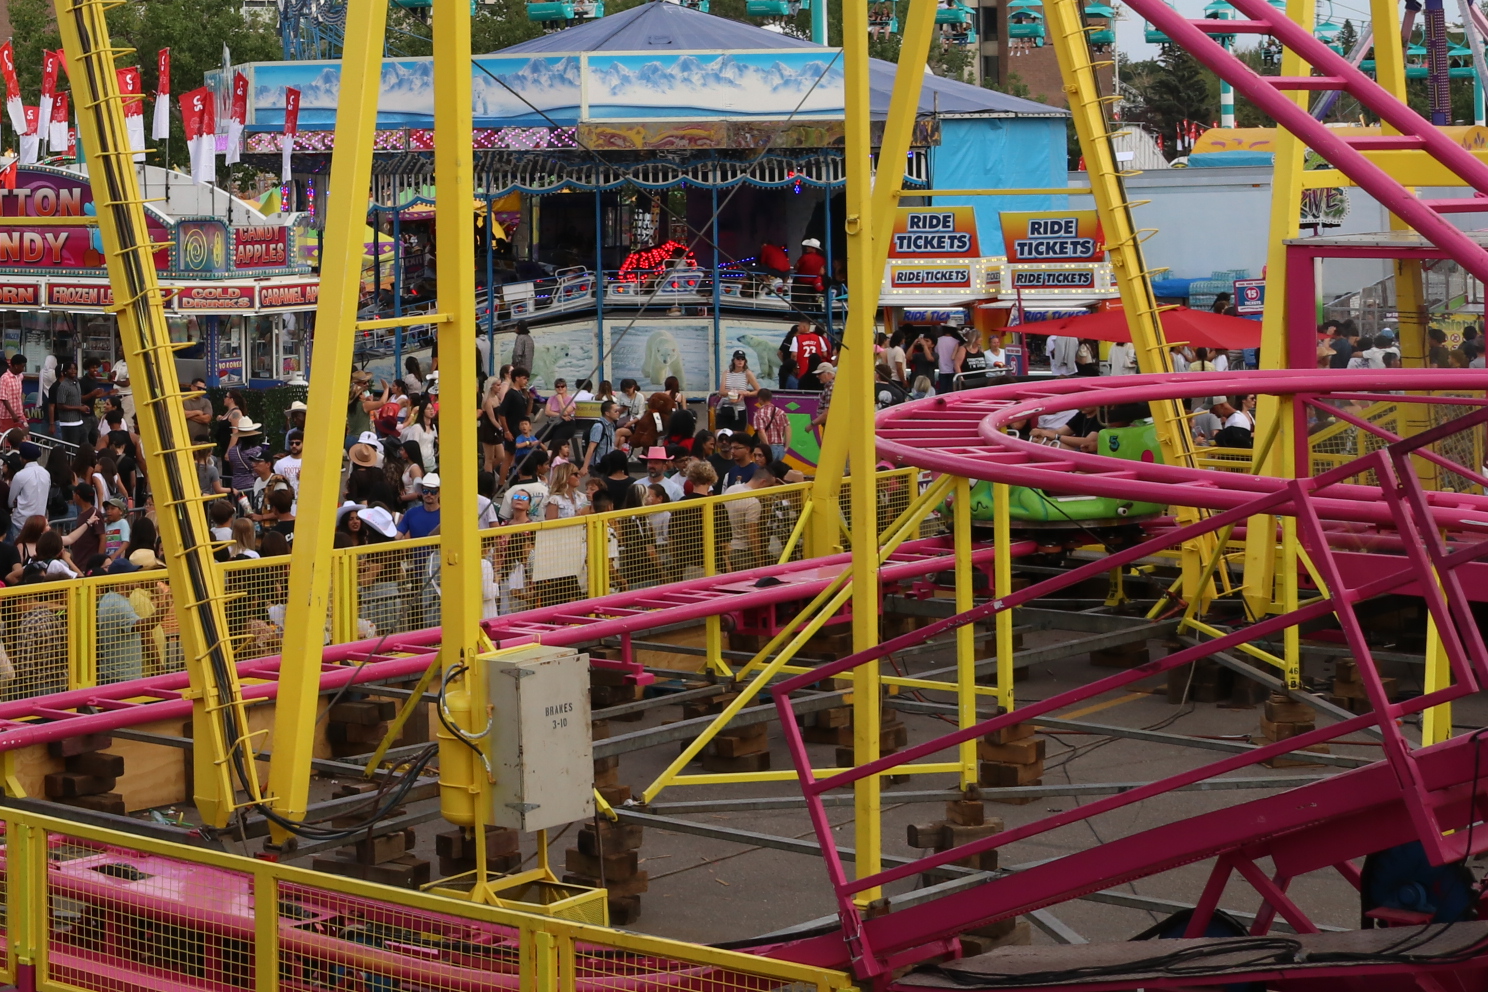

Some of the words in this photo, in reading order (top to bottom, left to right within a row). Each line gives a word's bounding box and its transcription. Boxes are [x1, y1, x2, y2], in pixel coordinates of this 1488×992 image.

[908, 212, 955, 231] RIDE
[1029, 218, 1077, 237] RIDE
[238, 227, 280, 242] CANDY
[895, 234, 970, 251] TICKETS
[1016, 239, 1095, 257] TICKETS
[236, 244, 285, 264] APPLES
[896, 270, 922, 282] RIDE
[924, 269, 968, 282] TICKETS
[1015, 272, 1043, 285] RIDE
[1045, 271, 1092, 284] TICKETS
[53, 286, 98, 305] FROZEN
[191, 288, 241, 298] COLD
[261, 287, 305, 306] CARAMEL
[1246, 289, 1258, 299] 15
[182, 298, 250, 309] DRINKS
[903, 310, 929, 321] RIDE
[1024, 310, 1049, 321] RIDE
[1109, 435, 1120, 452] 5
[1288, 667, 1299, 675] 46
[545, 702, 573, 717] BRAKES
[552, 717, 568, 729] 3-10
